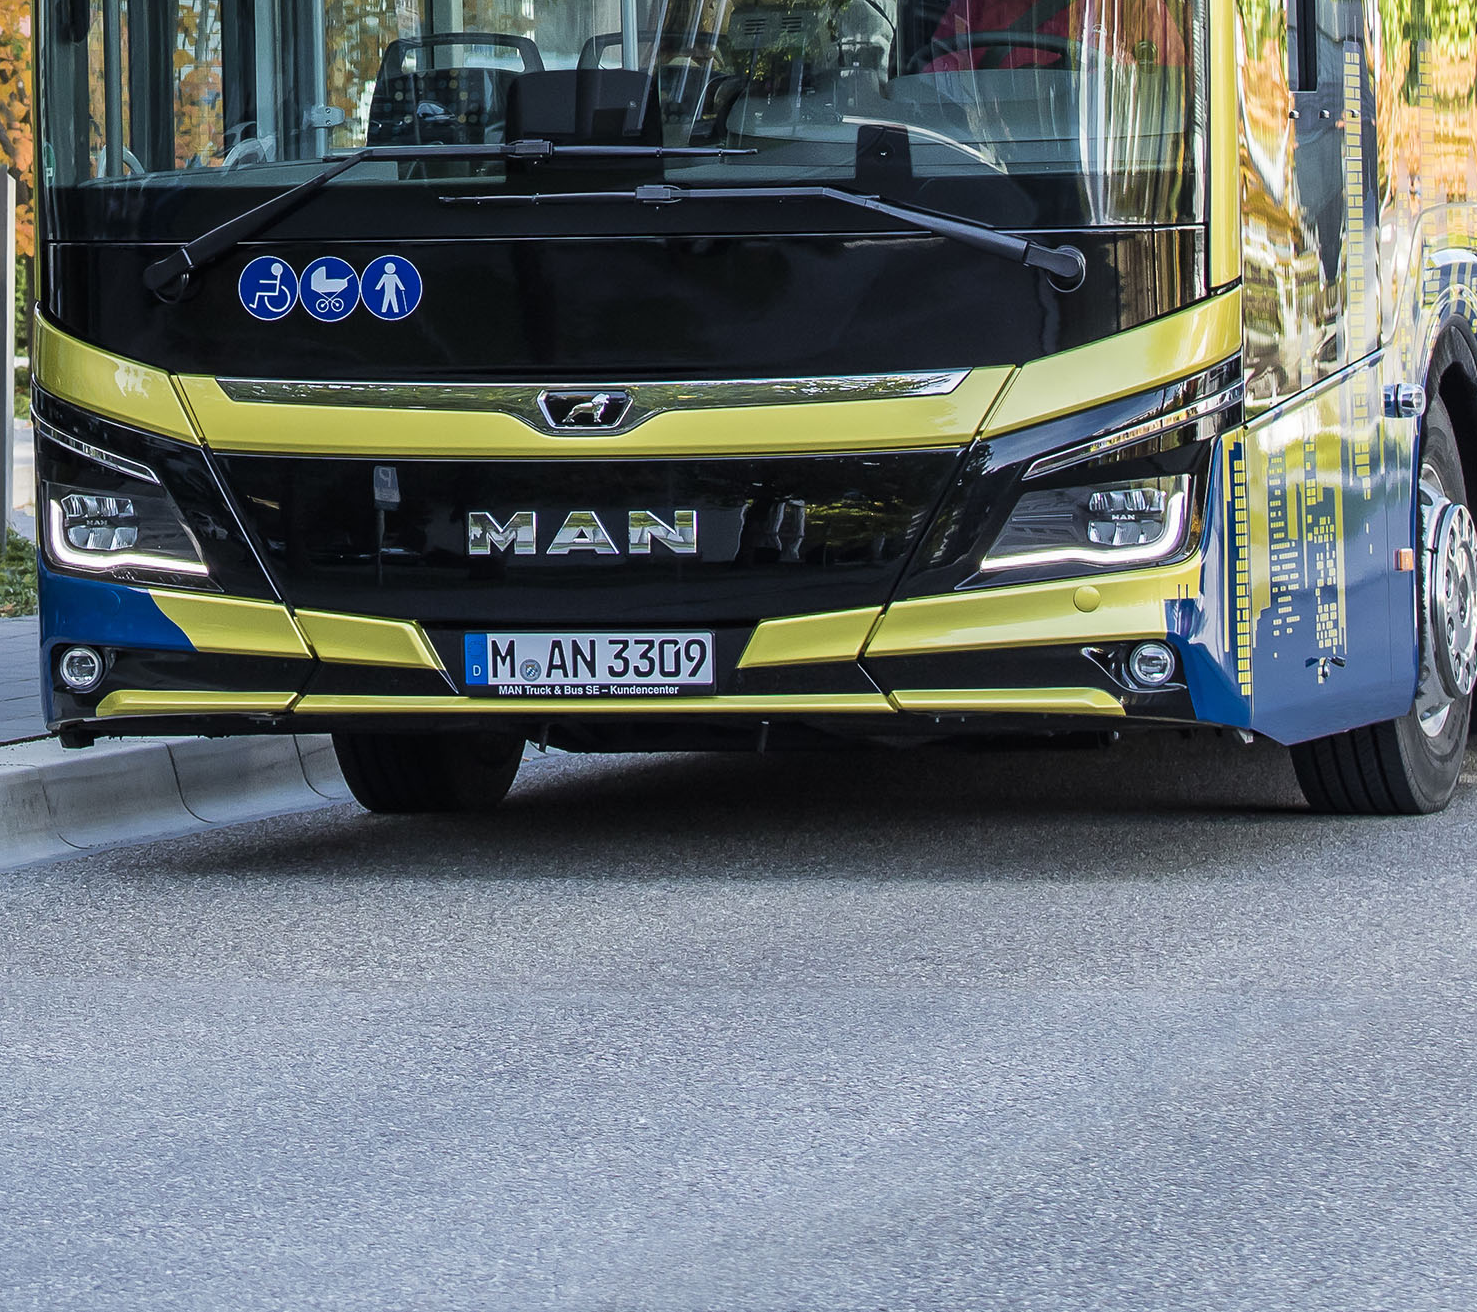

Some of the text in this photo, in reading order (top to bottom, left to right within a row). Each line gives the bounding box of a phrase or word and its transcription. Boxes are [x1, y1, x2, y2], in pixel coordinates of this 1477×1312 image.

[468, 510, 698, 555] MAN
[472, 638, 708, 679] D M AN 3309
[498, 685, 522, 695] MAN
[525, 685, 552, 695] Truck
[554, 685, 562, 695] &
[564, 685, 583, 695] Bus
[585, 685, 600, 695] SE
[610, 685, 679, 695] Kundencenter
